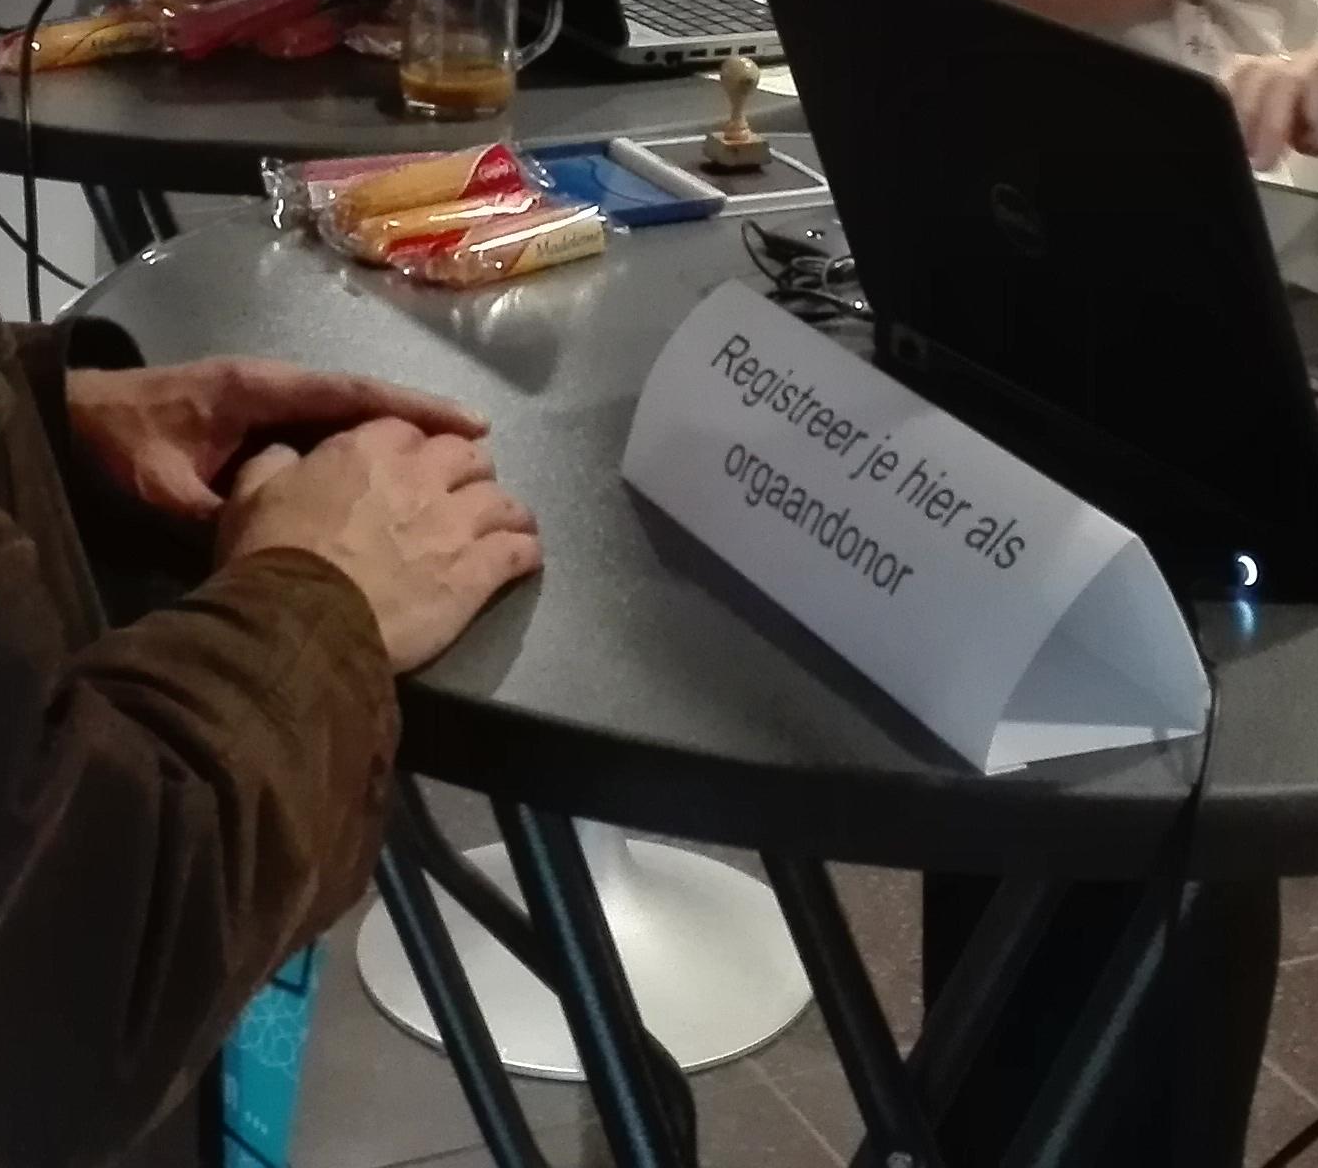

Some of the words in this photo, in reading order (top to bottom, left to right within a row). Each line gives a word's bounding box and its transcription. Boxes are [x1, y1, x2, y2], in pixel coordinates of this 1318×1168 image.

[710, 333, 869, 455] Registreer
[848, 433, 900, 482] je
[894, 456, 973, 528] hier
[964, 511, 1026, 570] als
[723, 443, 914, 596] orgaandonor
